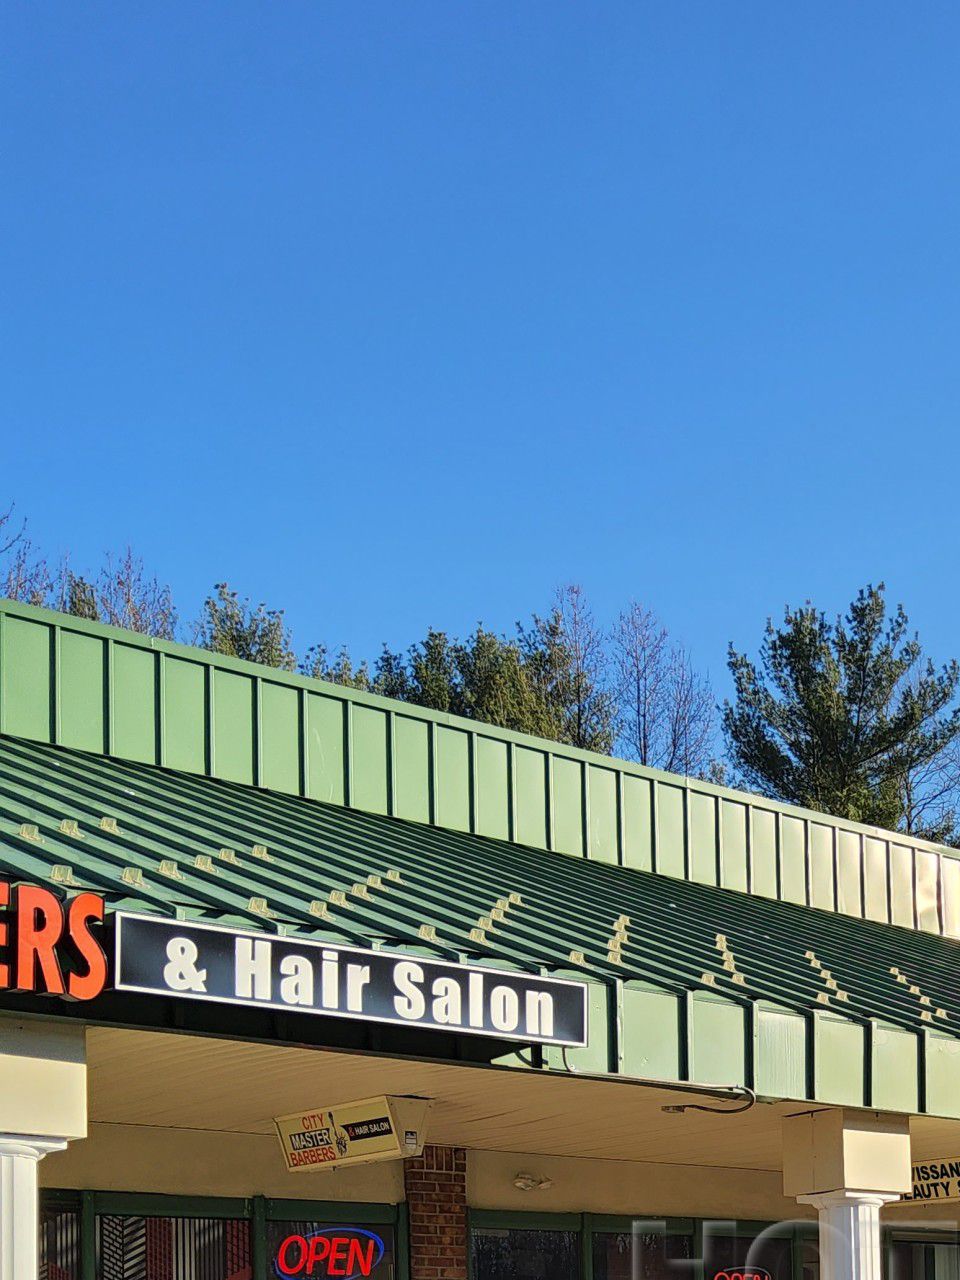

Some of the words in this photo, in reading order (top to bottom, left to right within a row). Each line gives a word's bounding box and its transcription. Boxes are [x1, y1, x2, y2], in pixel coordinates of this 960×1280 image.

[0, 882, 108, 1000] RS
[163, 937, 207, 992] &
[235, 937, 370, 1013] Hair
[393, 961, 553, 1037] Salon
[302, 1113, 326, 1131] CITY
[354, 1124, 368, 1135] HAIR
[369, 1121, 391, 1133] SALON
[291, 1130, 332, 1150] MASTER
[290, 1146, 337, 1167] BARBERS
[900, 1181, 950, 1200] AUTY
[278, 1235, 375, 1276] OPEN
